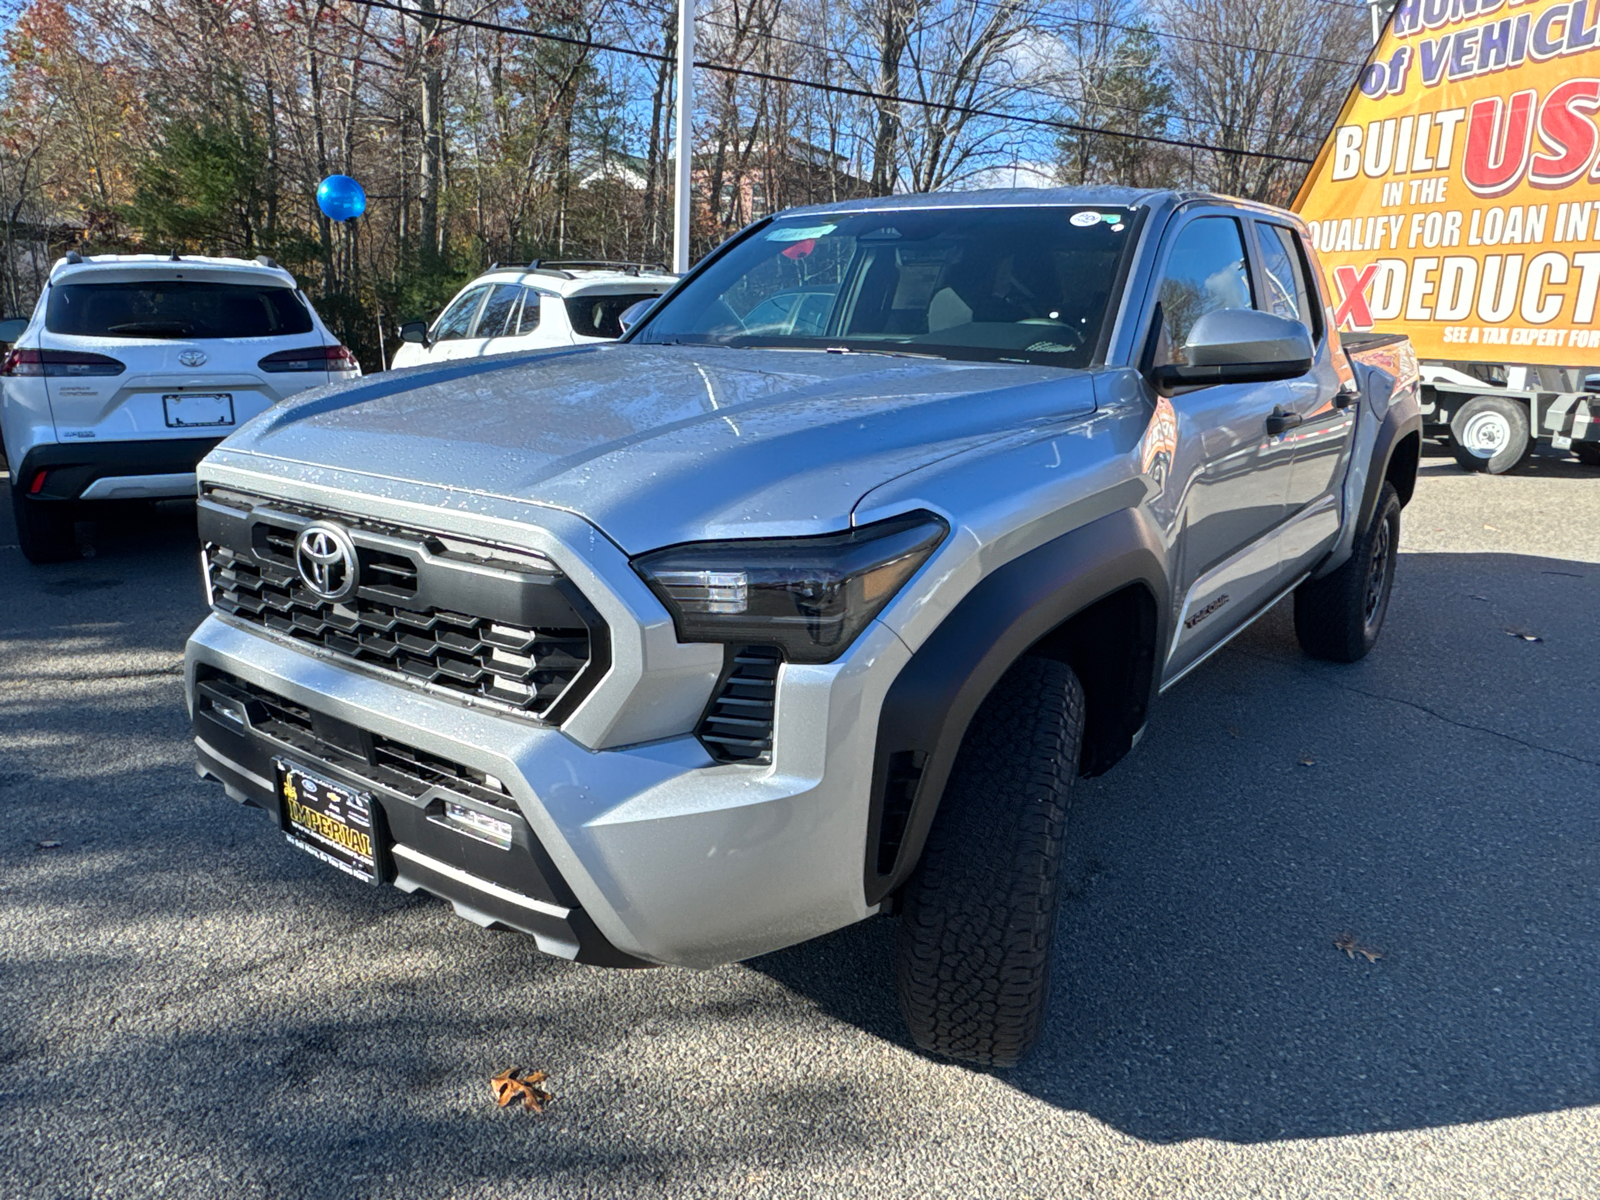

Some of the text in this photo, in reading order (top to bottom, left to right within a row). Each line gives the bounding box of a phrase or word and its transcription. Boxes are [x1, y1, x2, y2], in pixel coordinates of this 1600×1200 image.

[1359, 0, 1600, 99] of VEHICL
[1331, 107, 1467, 183] BUILT
[1461, 77, 1600, 198] US
[1381, 177, 1448, 208] IN THE
[1408, 210, 1463, 249] FOR
[1467, 204, 1549, 248] LOAN
[1443, 326, 1600, 348] SEE A TAX EXPERT FOR
[288, 799, 373, 859] IMPERIAL
